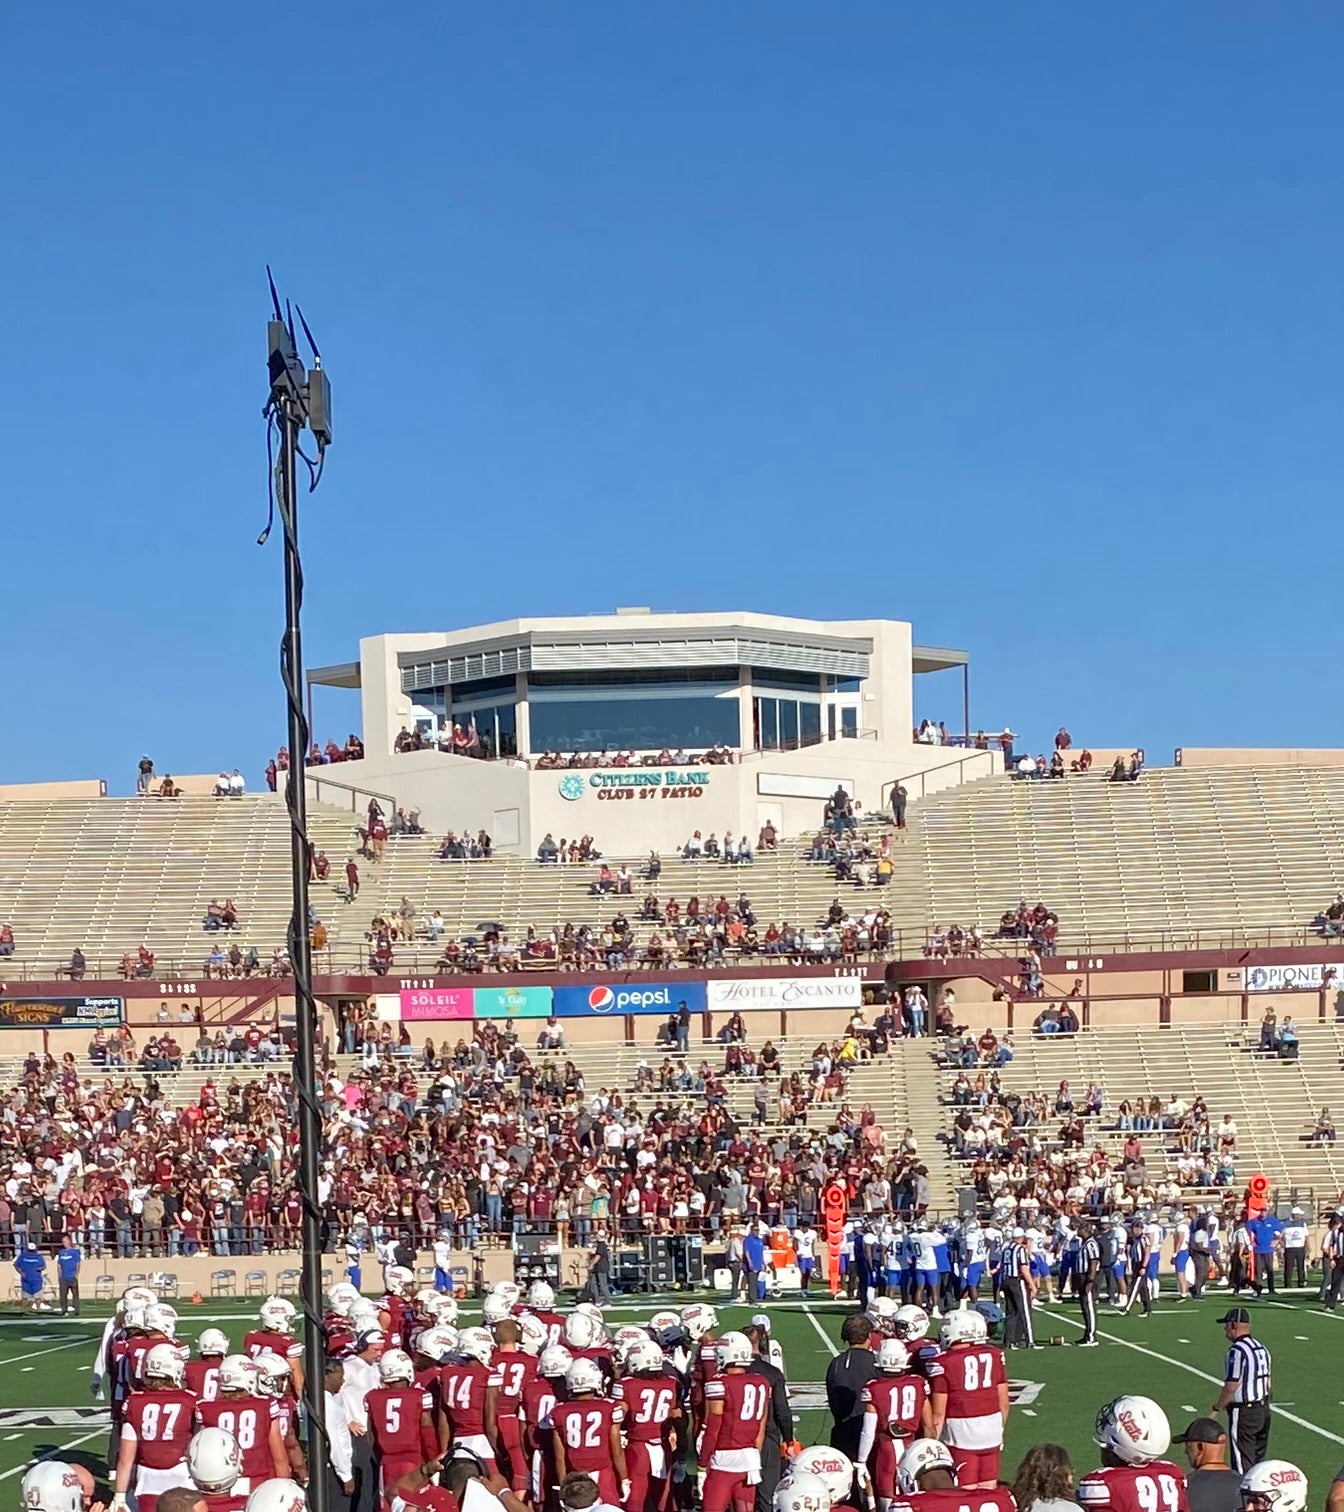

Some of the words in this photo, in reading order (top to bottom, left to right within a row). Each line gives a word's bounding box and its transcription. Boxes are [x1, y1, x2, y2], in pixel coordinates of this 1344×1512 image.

[589, 771, 662, 787] CITIZENS
[665, 771, 710, 785] BANK
[597, 788, 635, 800] CLUB
[661, 787, 703, 798] PATIO
[411, 995, 457, 1005] SOLEIL
[617, 988, 671, 1008] pepsi
[717, 982, 777, 1001] HOTEL
[779, 981, 855, 1001] ENCANTO
[411, 1005, 459, 1017] MIMOSA
[964, 1352, 993, 1391] 87
[448, 1375, 474, 1409] 14
[740, 1383, 767, 1421] 81
[888, 1385, 916, 1422] 18
[385, 1398, 402, 1434] 5
[635, 1388, 674, 1424] 36
[141, 1402, 182, 1442] 87
[566, 1411, 602, 1449] 82
[810, 1459, 845, 1476] State
[1269, 1469, 1301, 1487] State
